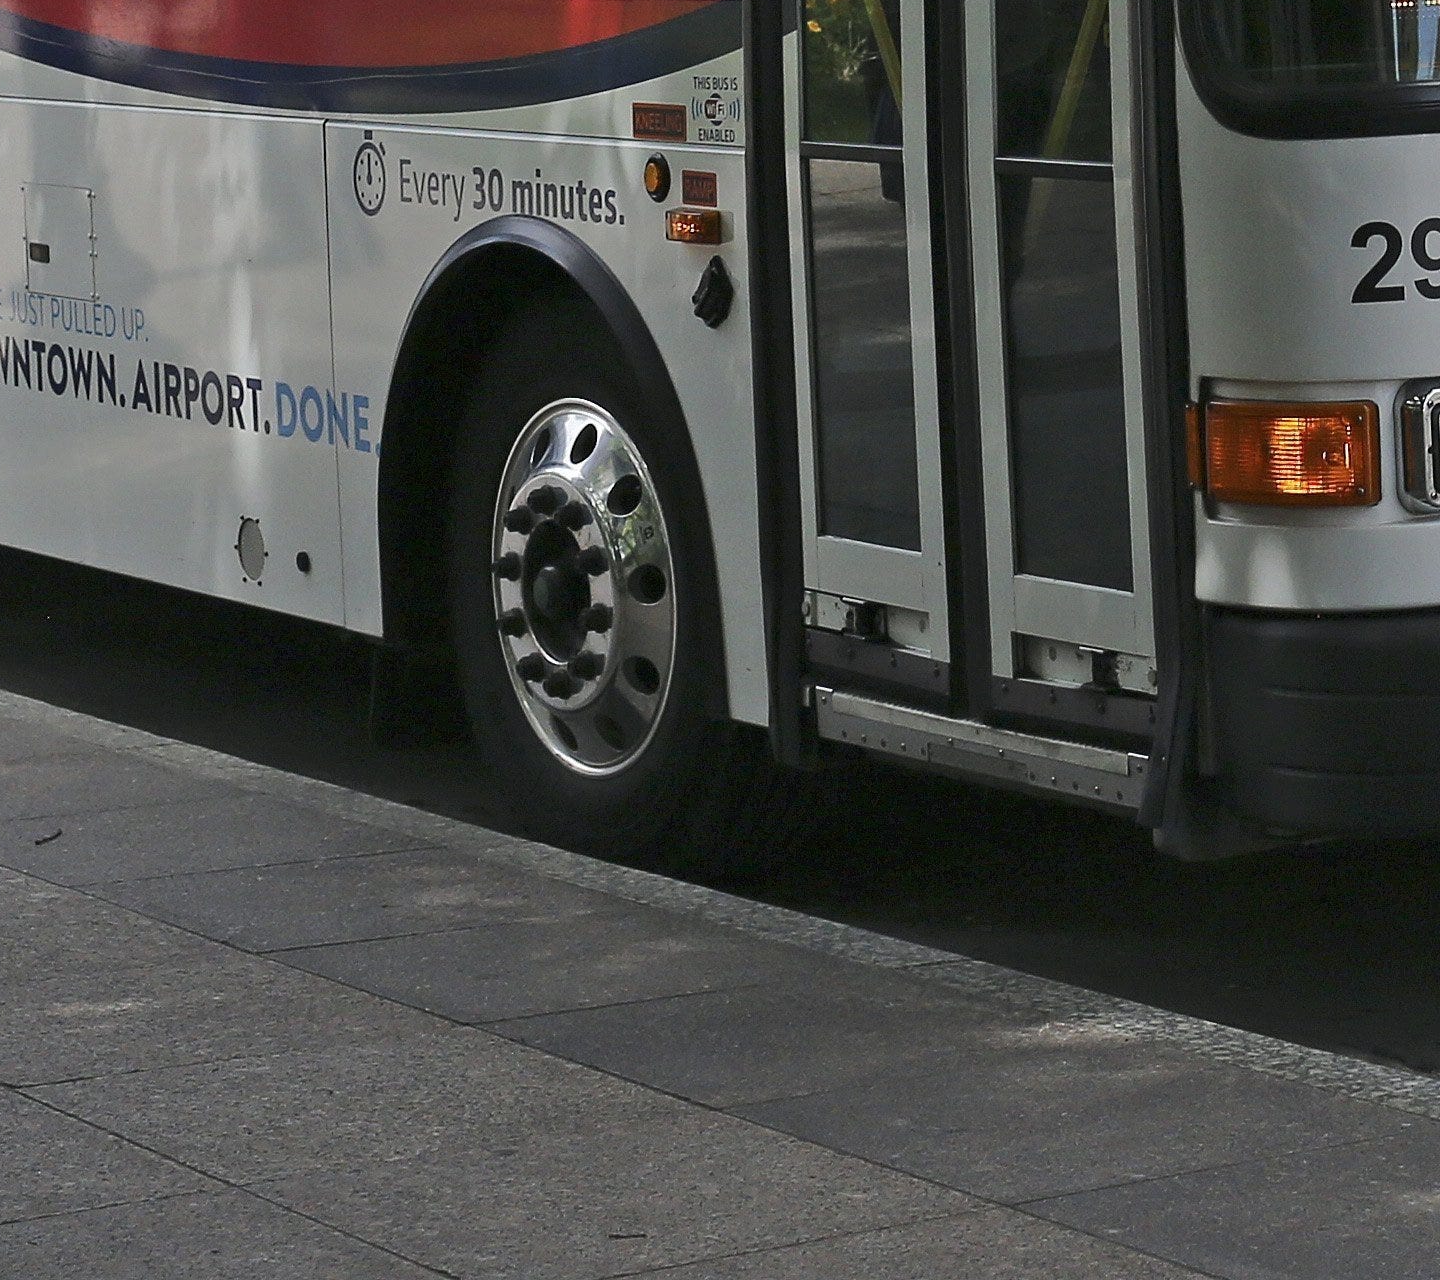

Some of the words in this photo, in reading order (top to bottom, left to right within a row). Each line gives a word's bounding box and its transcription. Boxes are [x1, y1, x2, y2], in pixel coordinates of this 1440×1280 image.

[693, 76, 711, 90] THIS
[712, 77, 729, 91] BUS
[730, 77, 738, 91] IS
[698, 128, 736, 143] ENABLED
[399, 158, 467, 222] Every
[472, 167, 503, 212] 30
[511, 168, 626, 225] minutes.
[9, 291, 45, 328] JUST
[51, 297, 116, 340] PULLED
[131, 357, 271, 436] AIRPORT.
